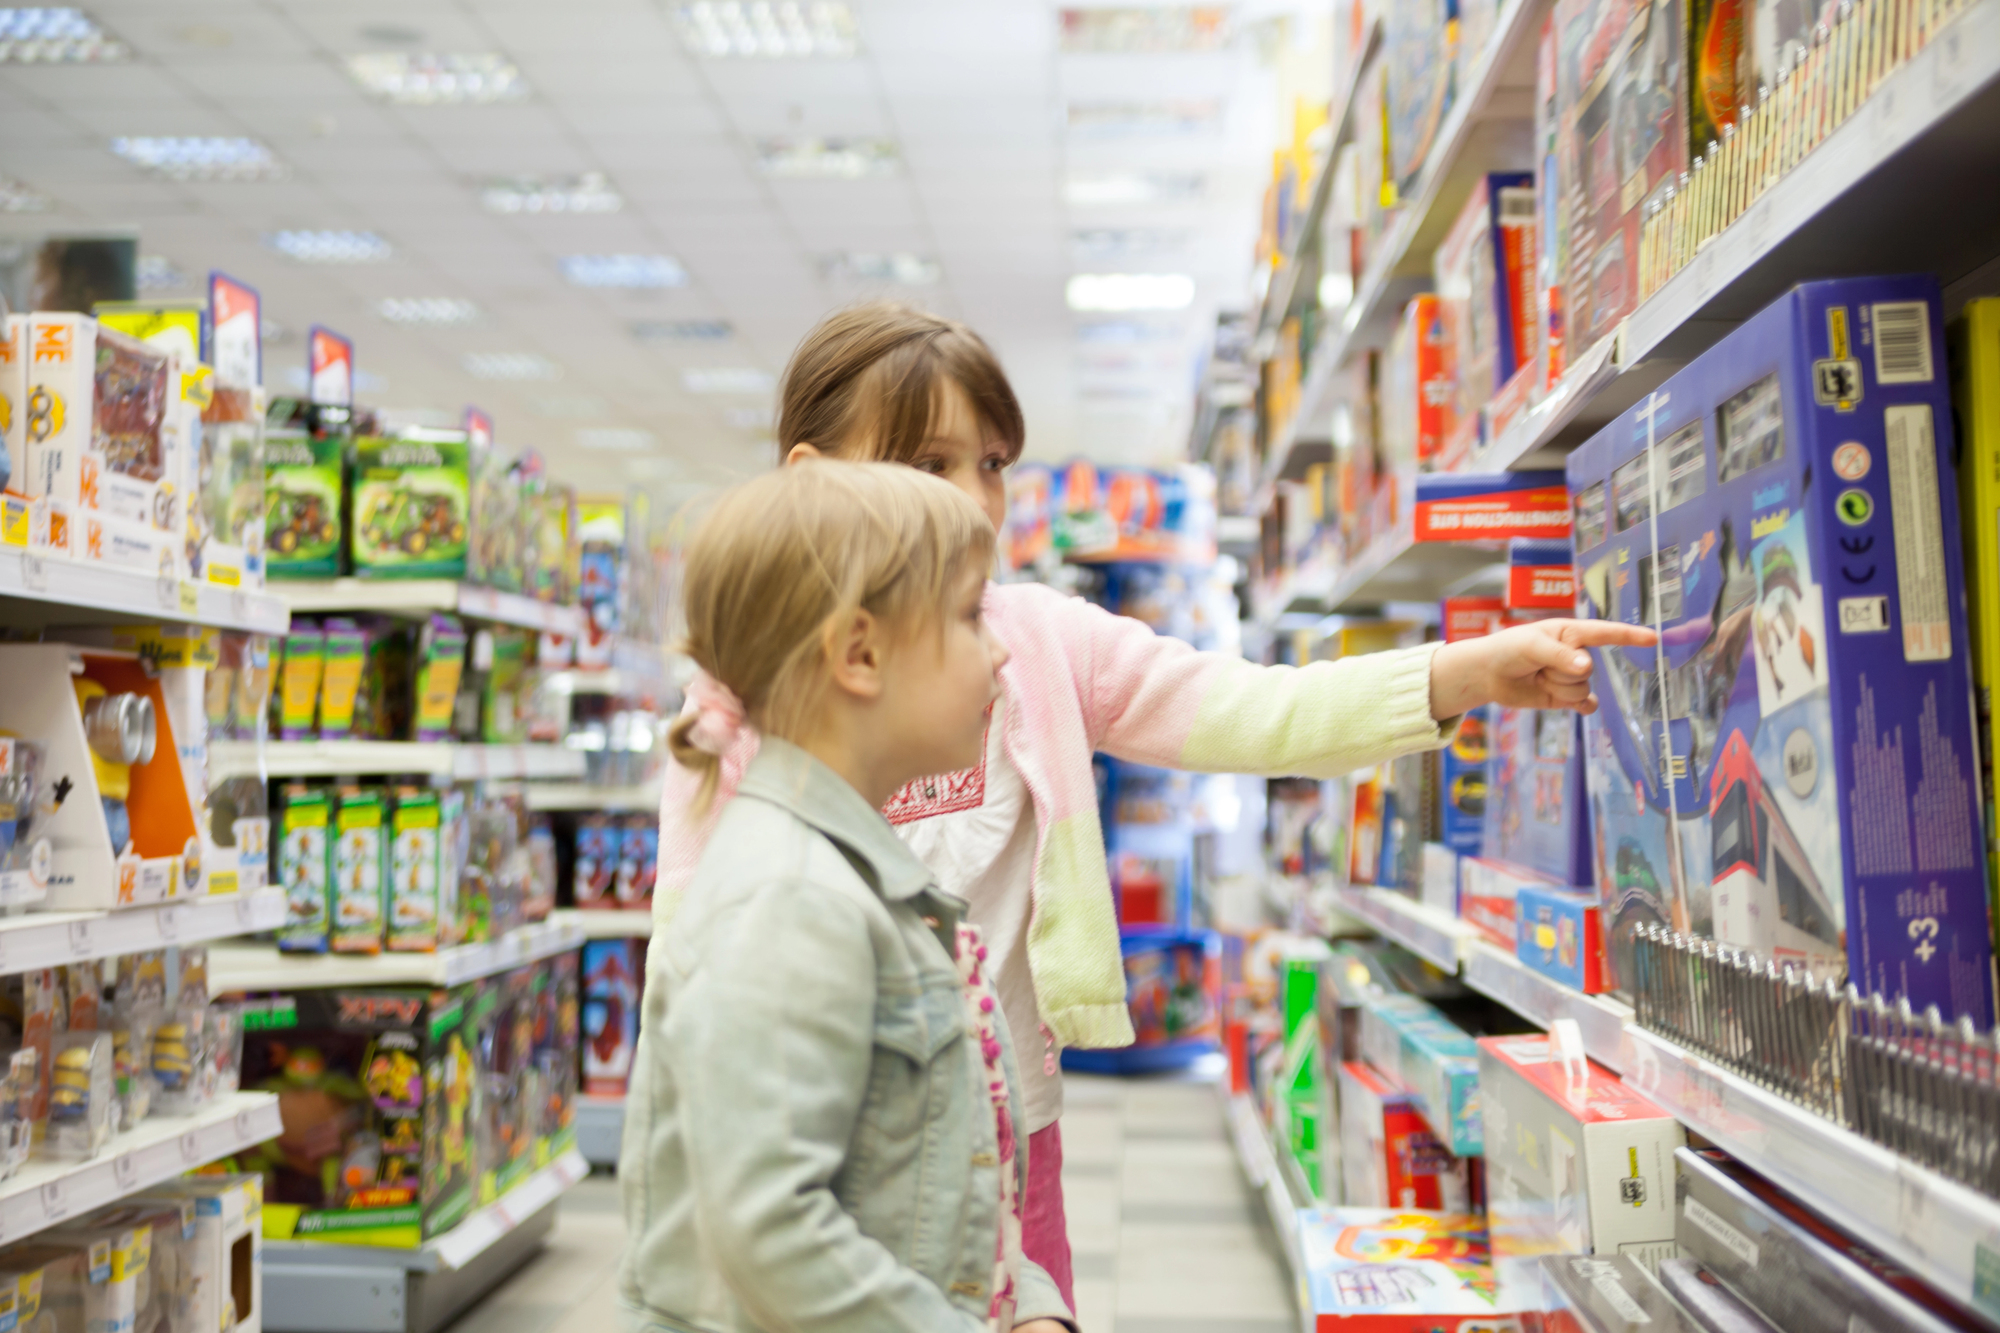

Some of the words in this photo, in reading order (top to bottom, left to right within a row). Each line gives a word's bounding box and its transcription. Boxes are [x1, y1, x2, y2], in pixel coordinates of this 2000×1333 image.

[35, 324, 65, 364] ME
[1428, 512, 1461, 531] SITE
[1462, 509, 1571, 529] CONSTRUCTION
[1531, 579, 1574, 597] SITE
[1907, 916, 1940, 964] +3
